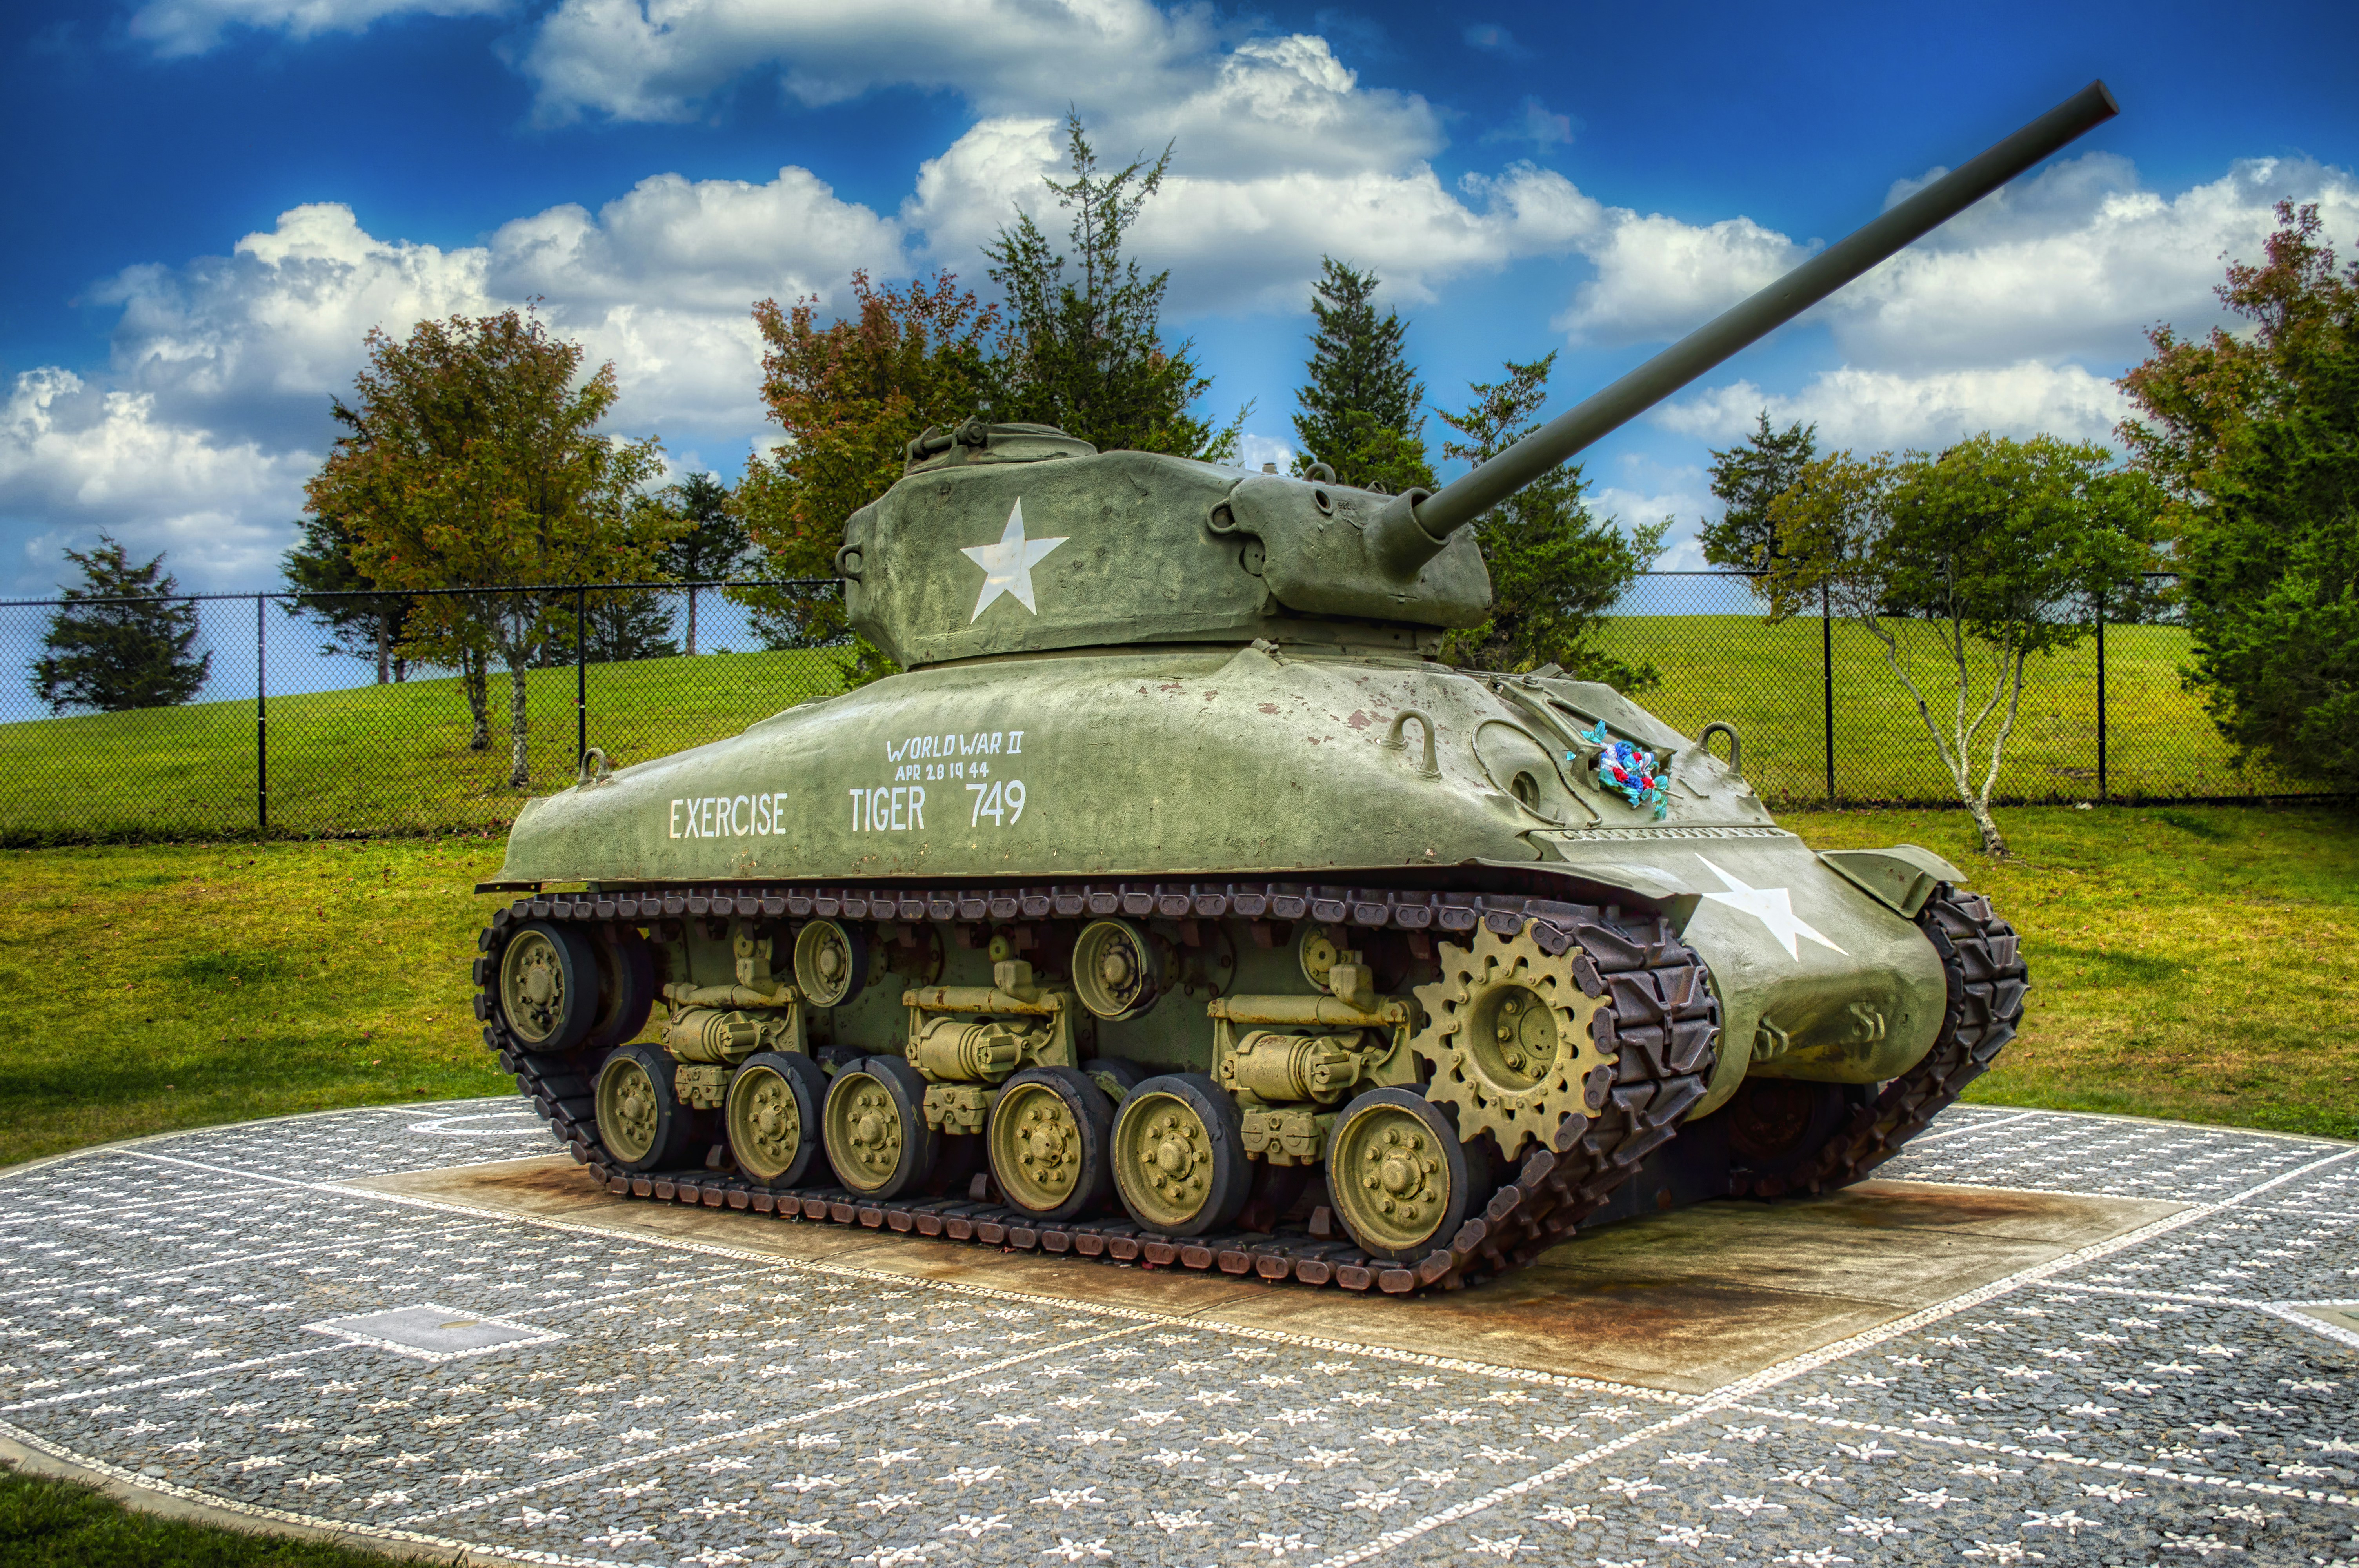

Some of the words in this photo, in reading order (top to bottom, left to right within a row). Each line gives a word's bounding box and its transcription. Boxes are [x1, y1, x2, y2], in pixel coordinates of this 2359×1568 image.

[887, 735, 956, 762] WORLD
[959, 732, 1002, 756] WAR
[1006, 731, 1024, 755] II
[894, 764, 921, 781] APR
[926, 763, 945, 780] 28
[670, 793, 787, 839] EXERCISE
[850, 786, 925, 831] TIGER
[966, 780, 1026, 828] 749
